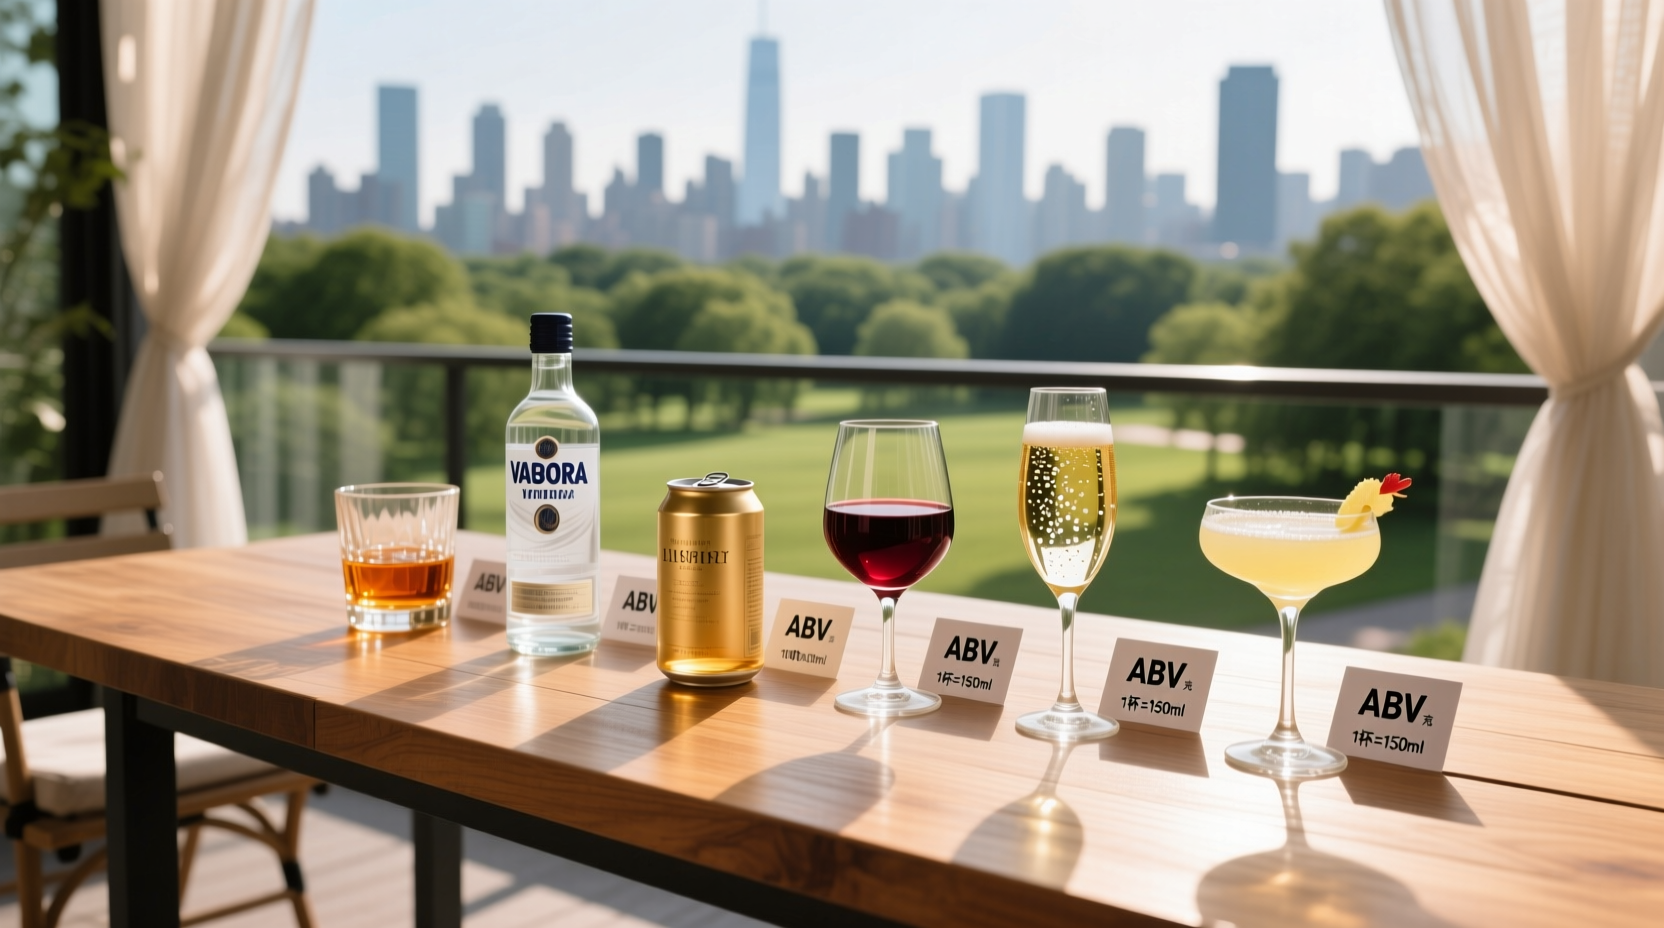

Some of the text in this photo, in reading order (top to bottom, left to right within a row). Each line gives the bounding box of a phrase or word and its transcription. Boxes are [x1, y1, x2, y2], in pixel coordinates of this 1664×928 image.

[510, 460, 588, 485] VABORA
[474, 573, 507, 594] ABV
[785, 614, 833, 641] ABV
[943, 635, 998, 665] ABV
[1126, 657, 1188, 688] ABV
[1358, 688, 1428, 723] ABV
